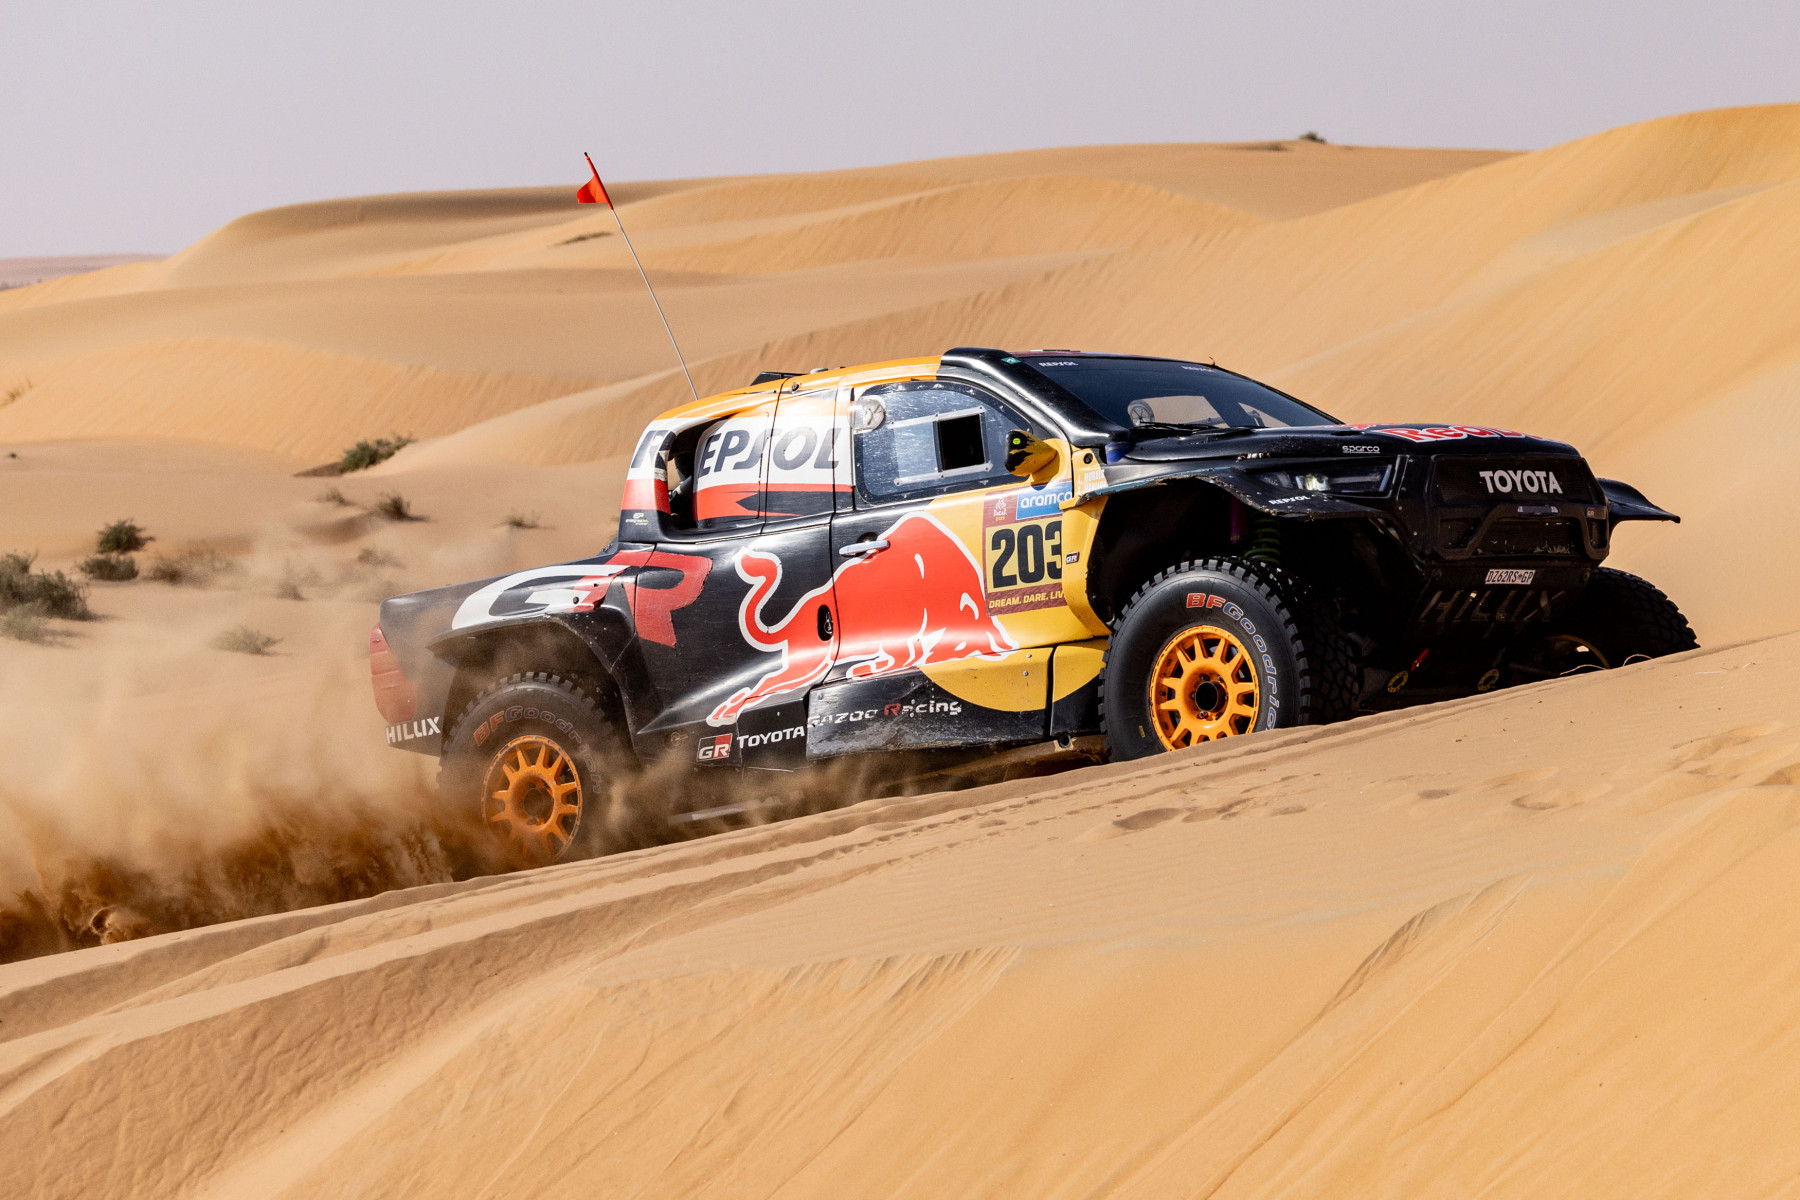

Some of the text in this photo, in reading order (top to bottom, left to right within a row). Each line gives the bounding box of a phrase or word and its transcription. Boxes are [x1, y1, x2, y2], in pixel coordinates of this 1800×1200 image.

[631, 426, 842, 479] REPSOL
[1342, 445, 1380, 454] sparco
[1479, 470, 1563, 494] TOYOTA
[1020, 490, 1072, 509] aramco
[991, 520, 1062, 589] 203
[989, 597, 1021, 609] DREAM.
[1023, 593, 1048, 604] DARE.
[1186, 593, 1280, 730] BFGoodric
[385, 716, 441, 744] HILUX
[699, 743, 730, 760] GR
[737, 726, 805, 748] TOYOTA
